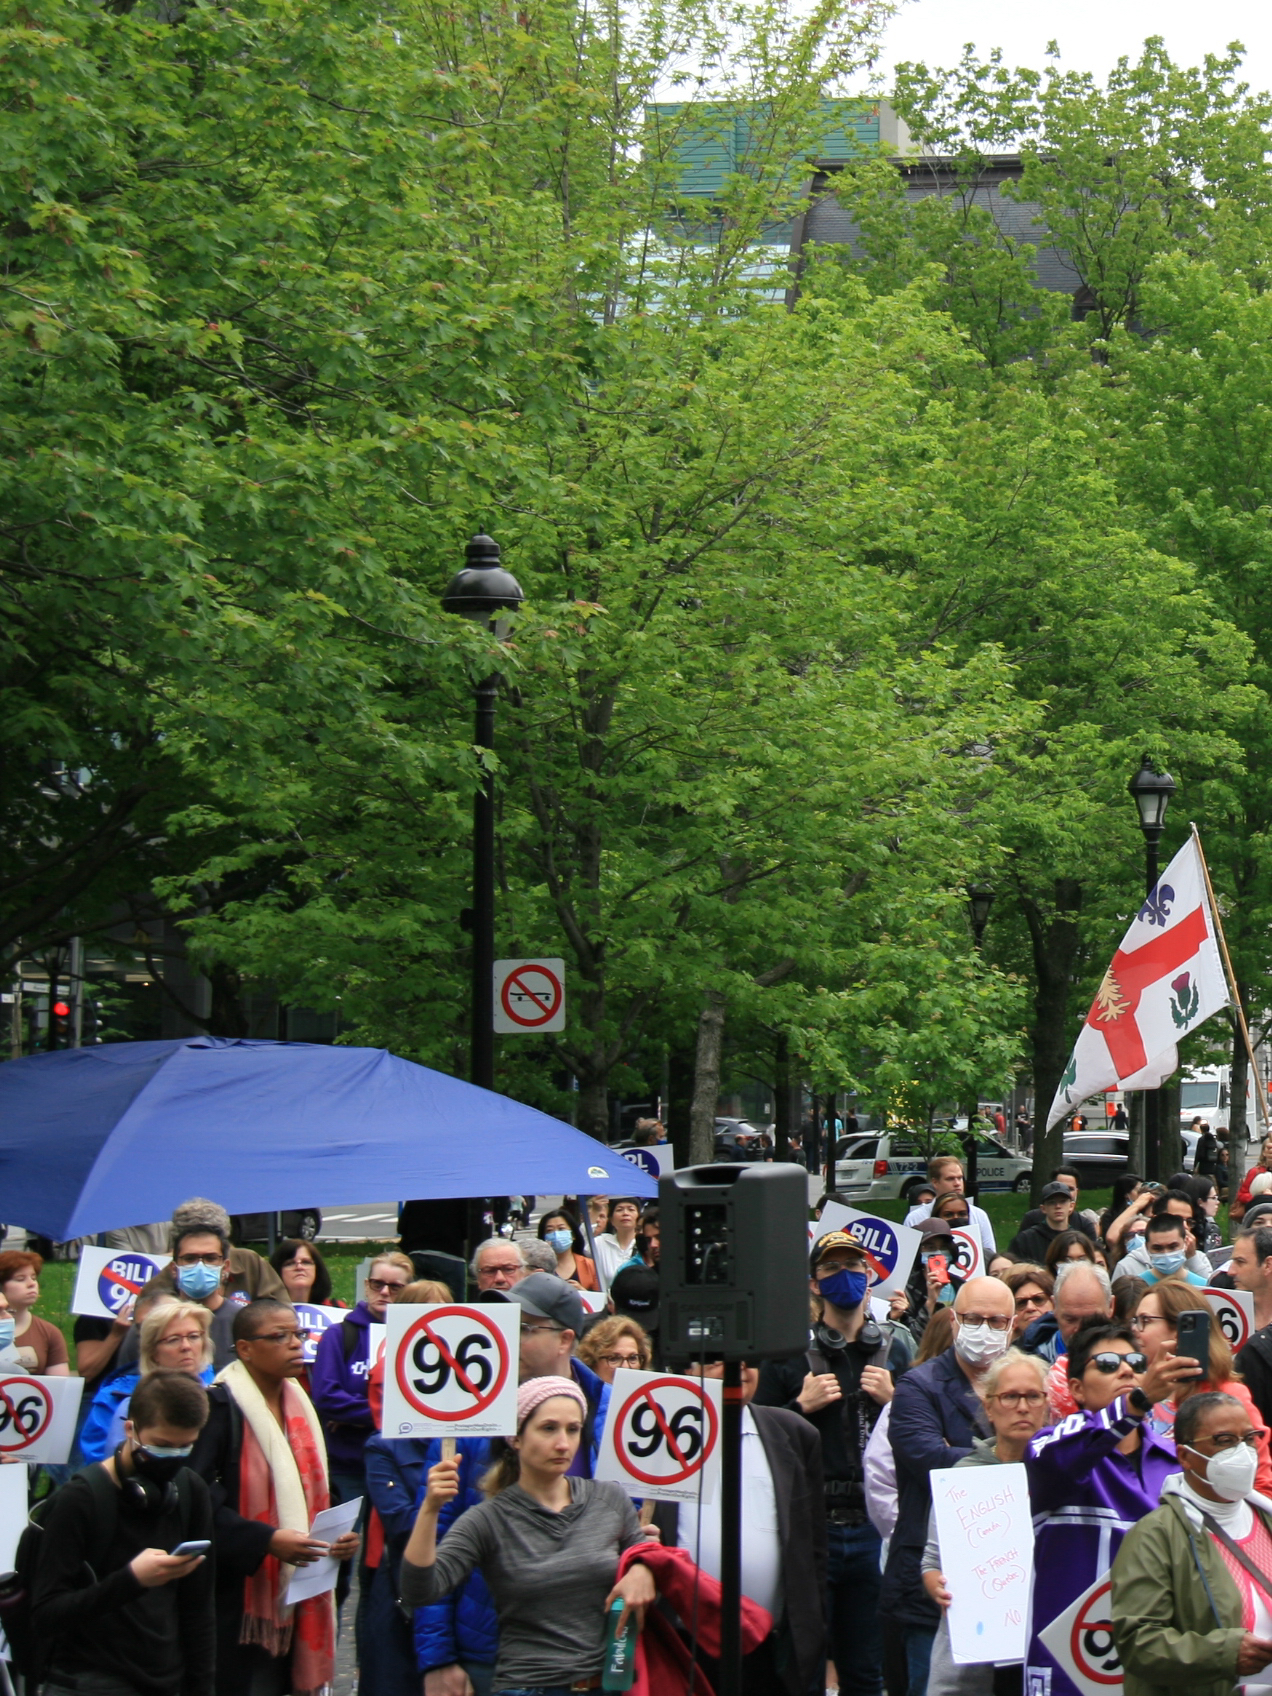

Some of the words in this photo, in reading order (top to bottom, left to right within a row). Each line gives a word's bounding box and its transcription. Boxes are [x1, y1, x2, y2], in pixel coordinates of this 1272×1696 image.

[976, 1167, 1005, 1177] POLICE
[850, 1223, 892, 1255] BILL
[297, 1311, 329, 1330] ILL
[412, 1333, 493, 1394] 96
[628, 1401, 704, 1462] 96
[945, 1485, 968, 1503] The
[956, 1485, 1015, 1530] ENGLISH
[971, 1564, 988, 1580] The
[986, 1548, 1019, 1573] FRENCH
[1005, 1609, 1022, 1627] NO
